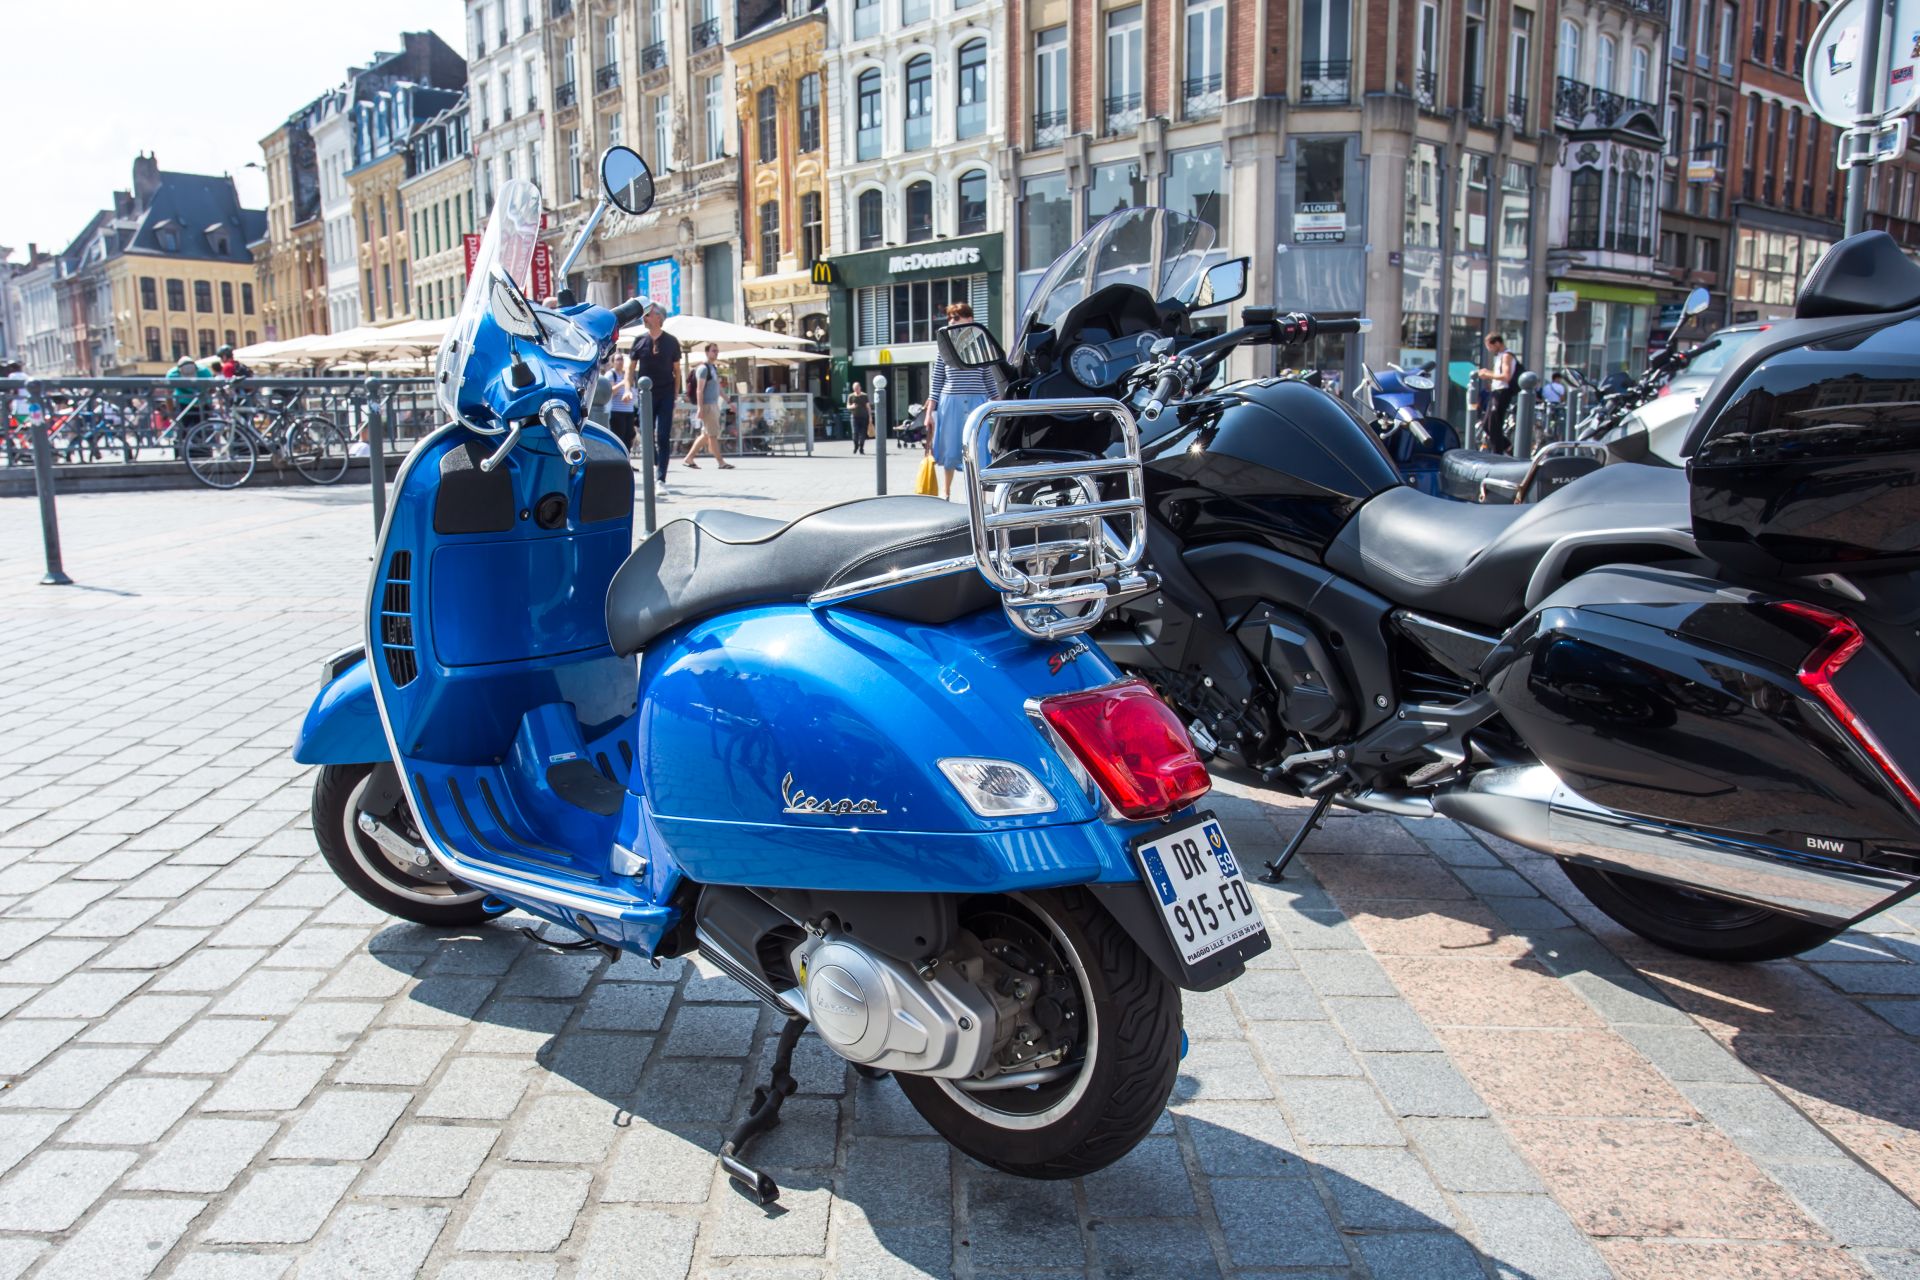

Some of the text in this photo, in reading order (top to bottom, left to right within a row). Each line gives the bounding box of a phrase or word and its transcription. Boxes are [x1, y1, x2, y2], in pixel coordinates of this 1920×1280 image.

[1310, 204, 1337, 212] LOUER
[535, 250, 545, 267] du
[888, 247, 980, 273] McDonald's
[1048, 643, 1089, 674] Super
[782, 772, 888, 816] Vespa
[1807, 837, 1844, 853] BMW
[1217, 852, 1234, 873] 59
[1161, 882, 1168, 896] F
[1174, 879, 1253, 943] 915-FD
[1187, 946, 1211, 962] PIAGGIO
[1210, 939, 1225, 951] LILLE
